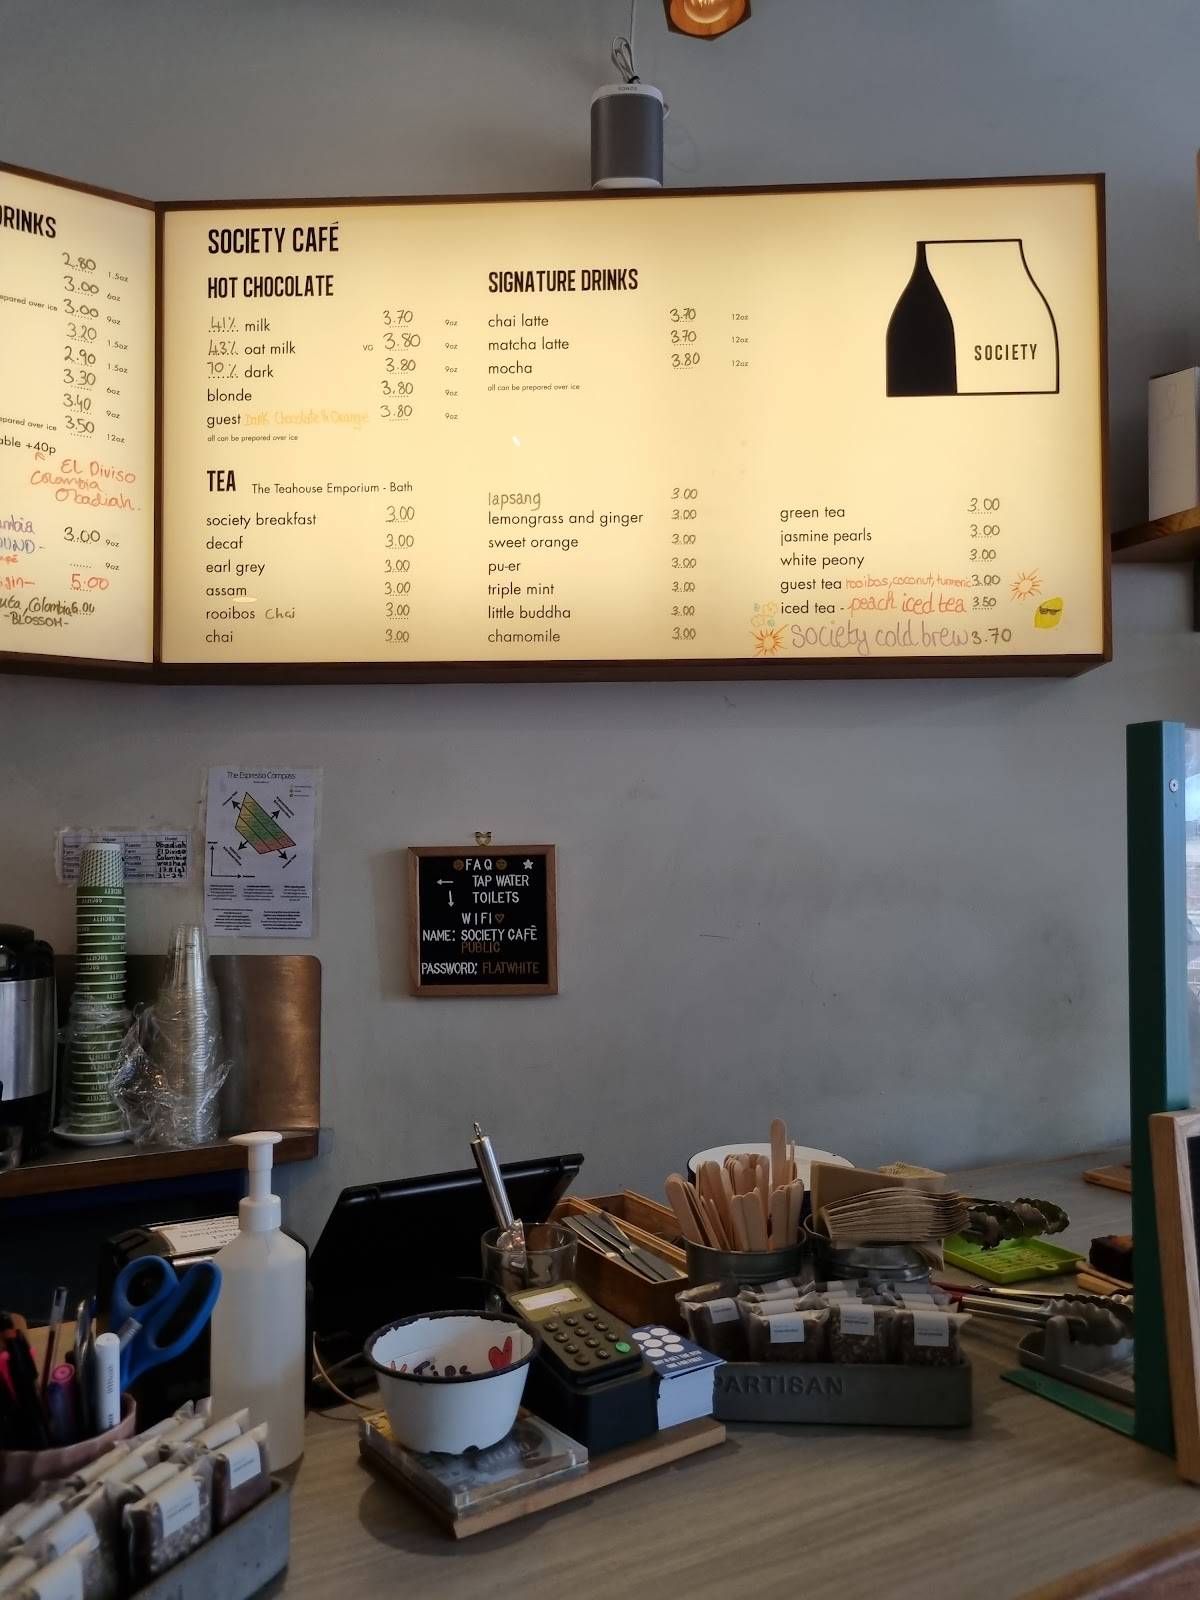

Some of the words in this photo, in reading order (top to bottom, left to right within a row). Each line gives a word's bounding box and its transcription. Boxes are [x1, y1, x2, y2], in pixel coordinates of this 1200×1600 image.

[0, 204, 57, 239] RINKS
[208, 228, 286, 254] SOCIETY
[292, 221, 339, 252] CAFÉ
[62, 252, 97, 271] 2.80
[107, 271, 128, 283] 1.5oz
[63, 276, 100, 294] 3.00
[106, 292, 121, 302] 6oz
[207, 277, 239, 299] HOT
[243, 275, 334, 298] CHOCOLATE
[488, 270, 576, 293] SIGNATURE
[581, 268, 639, 291] DRINKS
[63, 299, 99, 318] 3.00
[106, 315, 121, 326] 9oz
[245, 318, 271, 332] milk
[382, 309, 414, 326] 3.70
[445, 319, 458, 327] 9oz
[488, 314, 516, 327] chai
[521, 313, 549, 327] latte
[669, 307, 696, 323] 3.70
[66, 322, 97, 340] 3.20
[107, 340, 128, 350] 1.5oz
[244, 343, 266, 355] oat
[270, 341, 296, 355] milk
[362, 344, 374, 352] VG
[383, 332, 421, 350] 3.80
[445, 343, 458, 351] 9oz
[488, 336, 536, 351] matcha
[542, 336, 570, 350] latte
[671, 330, 697, 344] 3.70
[64, 346, 96, 365] 2.90
[107, 363, 128, 374] 1.5oz
[974, 344, 1037, 361] SOCIETY
[244, 365, 274, 378] dark
[385, 358, 416, 373] 3.80
[445, 366, 458, 374] 9oz
[488, 360, 533, 374] mocha
[671, 353, 700, 368] 3.80
[63, 369, 96, 386] 3.30
[106, 386, 121, 396] 6oz
[207, 389, 252, 402] blonde
[380, 380, 414, 396] 3.80
[522, 384, 552, 392] prepared
[63, 394, 91, 410] 3.40
[106, 410, 121, 419] 9oz
[207, 413, 241, 428] guest
[380, 404, 413, 418] 3.80
[445, 413, 458, 421] 9oz
[65, 416, 95, 433] 3.50
[106, 433, 125, 444] 12oz
[207, 434, 215, 442] all
[241, 434, 271, 444] prepared
[26, 441, 56, 456] +40p
[207, 470, 236, 492] TEA
[252, 484, 270, 494] The
[274, 483, 322, 494] Teahouse
[326, 483, 379, 496] Emporium
[390, 481, 413, 492] Bath
[488, 492, 541, 511] lapsang
[671, 488, 698, 500] 3.00
[206, 513, 251, 529] society
[256, 512, 317, 526] breakfast
[386, 505, 415, 522] 3.00
[488, 512, 564, 528] lemongrass
[568, 510, 595, 524] and
[599, 512, 644, 527] ginger
[671, 509, 697, 520] 3.00
[780, 507, 819, 522] green
[824, 506, 845, 518] tea
[968, 498, 1000, 512] 3.00
[63, 526, 101, 543] 3.00
[105, 538, 120, 548] 9oz
[206, 536, 243, 550] decaf
[385, 533, 415, 548] 3.00
[488, 537, 526, 549] sweet
[530, 538, 579, 551] orange
[671, 533, 696, 545] 3.00
[780, 531, 829, 546] jasmine
[833, 528, 872, 545] pearls
[970, 524, 1000, 537] 3.00
[105, 562, 120, 571] 9oz
[206, 560, 231, 573] earl
[236, 562, 265, 576] grey
[384, 559, 410, 573] 3.00
[488, 561, 521, 575] pu-er
[671, 557, 697, 568] 3.00
[780, 554, 816, 566] white
[822, 555, 865, 569] peony
[969, 549, 997, 561] 3.00
[71, 573, 109, 591] 5.00
[206, 585, 247, 596] assam
[384, 582, 411, 596] 3.00
[488, 582, 521, 599] triple
[526, 584, 555, 596] mint
[671, 581, 696, 592] 3.00
[780, 578, 816, 592] guest
[821, 577, 842, 590] tea
[971, 574, 1000, 586] 3.00
[206, 607, 255, 620] rooibos
[385, 602, 410, 617] 3.00
[488, 605, 514, 619] little
[519, 605, 571, 619] buddha
[671, 605, 695, 616] 3.00
[780, 602, 808, 614] iced
[815, 602, 835, 614] tea
[848, 591, 897, 617] peach
[902, 592, 935, 614] iced
[938, 593, 967, 613] tea
[972, 597, 996, 608] 3.50
[205, 630, 233, 643] chai
[384, 629, 410, 643] 3.00
[488, 629, 561, 643] chamomile
[671, 627, 696, 640] 3.00
[875, 619, 919, 647] cold
[921, 621, 968, 647] brew
[971, 627, 1012, 645] 3.70
[465, 859, 493, 871] FAQ
[472, 875, 492, 887] TAP
[496, 874, 529, 887] WATER
[472, 891, 520, 904] TOILETS
[461, 912, 492, 925] WIFI
[422, 929, 456, 942] NAME:
[461, 929, 505, 941] SOCIETY
[507, 925, 538, 942] CAFÉ
[461, 941, 500, 953] PUBLIC
[421, 962, 478, 975] PASSWORD:
[482, 962, 540, 974] FLATWHITE
